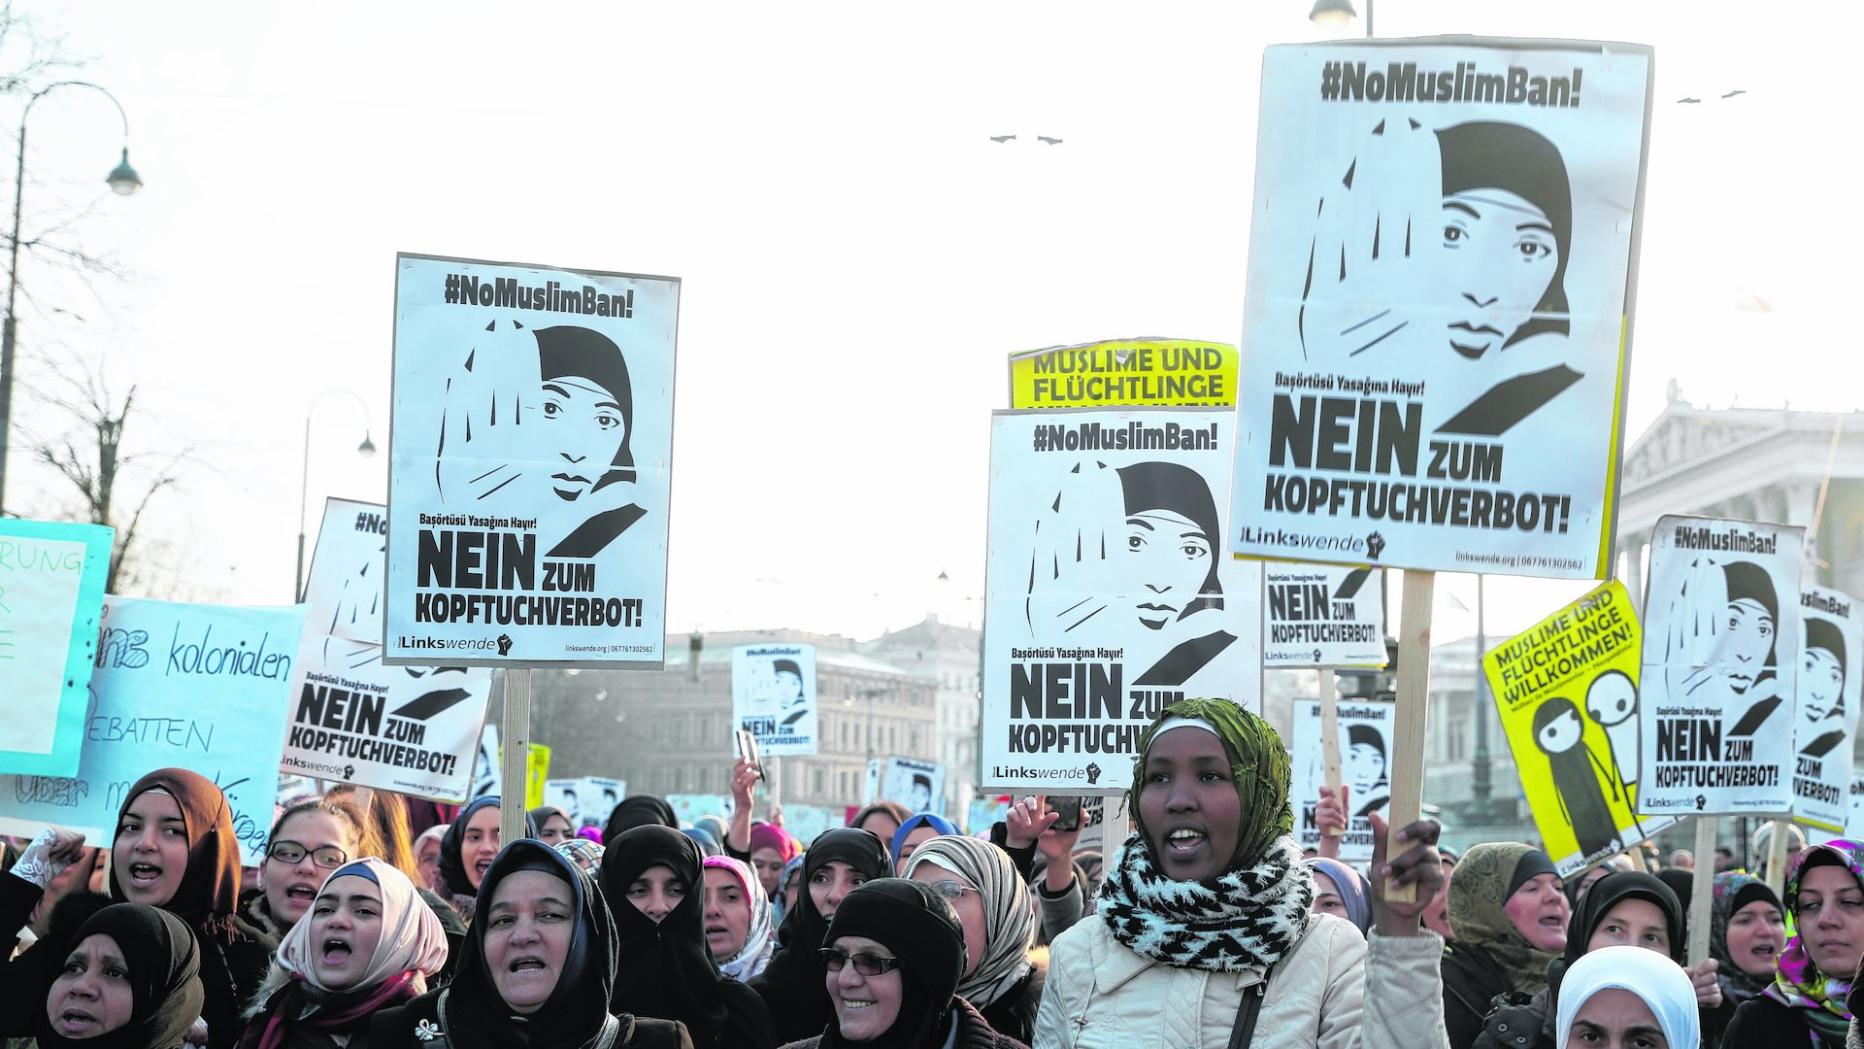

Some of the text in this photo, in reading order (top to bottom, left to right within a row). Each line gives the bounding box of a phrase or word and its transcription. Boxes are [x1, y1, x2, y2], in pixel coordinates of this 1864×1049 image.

[1321, 61, 1583, 108] #NoMuslimBan!
[444, 273, 634, 318] #NoMuslimBan!
[1033, 348, 1223, 375] MUSLIME UND
[1033, 375, 1224, 401] FLÜCHTLINGE
[1034, 421, 1218, 452] #NoMuslimBan!
[1268, 393, 1504, 484] NEIN ZUM
[419, 513, 537, 531] Başörtüsü Yasağına Hayır!
[1264, 474, 1571, 535] KOPFTUCHVERBOT!
[1244, 526, 1364, 552] Linkswende
[1674, 526, 1777, 554] #NoMuslimBan!
[417, 530, 596, 592] NEIN ZUM
[415, 592, 643, 627] KOPFTUCHVERBOT!
[1268, 585, 1356, 621] NEIN ZUM
[402, 636, 496, 650] Linkswende
[1272, 624, 1376, 643] KOPFTUCHVERBOT!
[1495, 614, 1571, 668] MUSLIME
[1574, 590, 1613, 622] UND
[166, 621, 291, 682] kolonialen
[1011, 647, 1055, 661] Başörtüsü
[1057, 646, 1095, 661] Yasağına
[1504, 622, 1633, 704] WILLKOMMEN!
[1010, 663, 1123, 719] NEIN
[295, 683, 426, 746] NEIN ZUM
[288, 725, 457, 776] KOPFTUCHVERBOT!
[1656, 719, 1754, 762] NEIN ZUM
[281, 755, 344, 775] inkswende
[996, 766, 1085, 779] Linkswende
[1656, 765, 1779, 788] KOPFTUCHVERBOT!
[1795, 756, 1822, 779] ZUM
